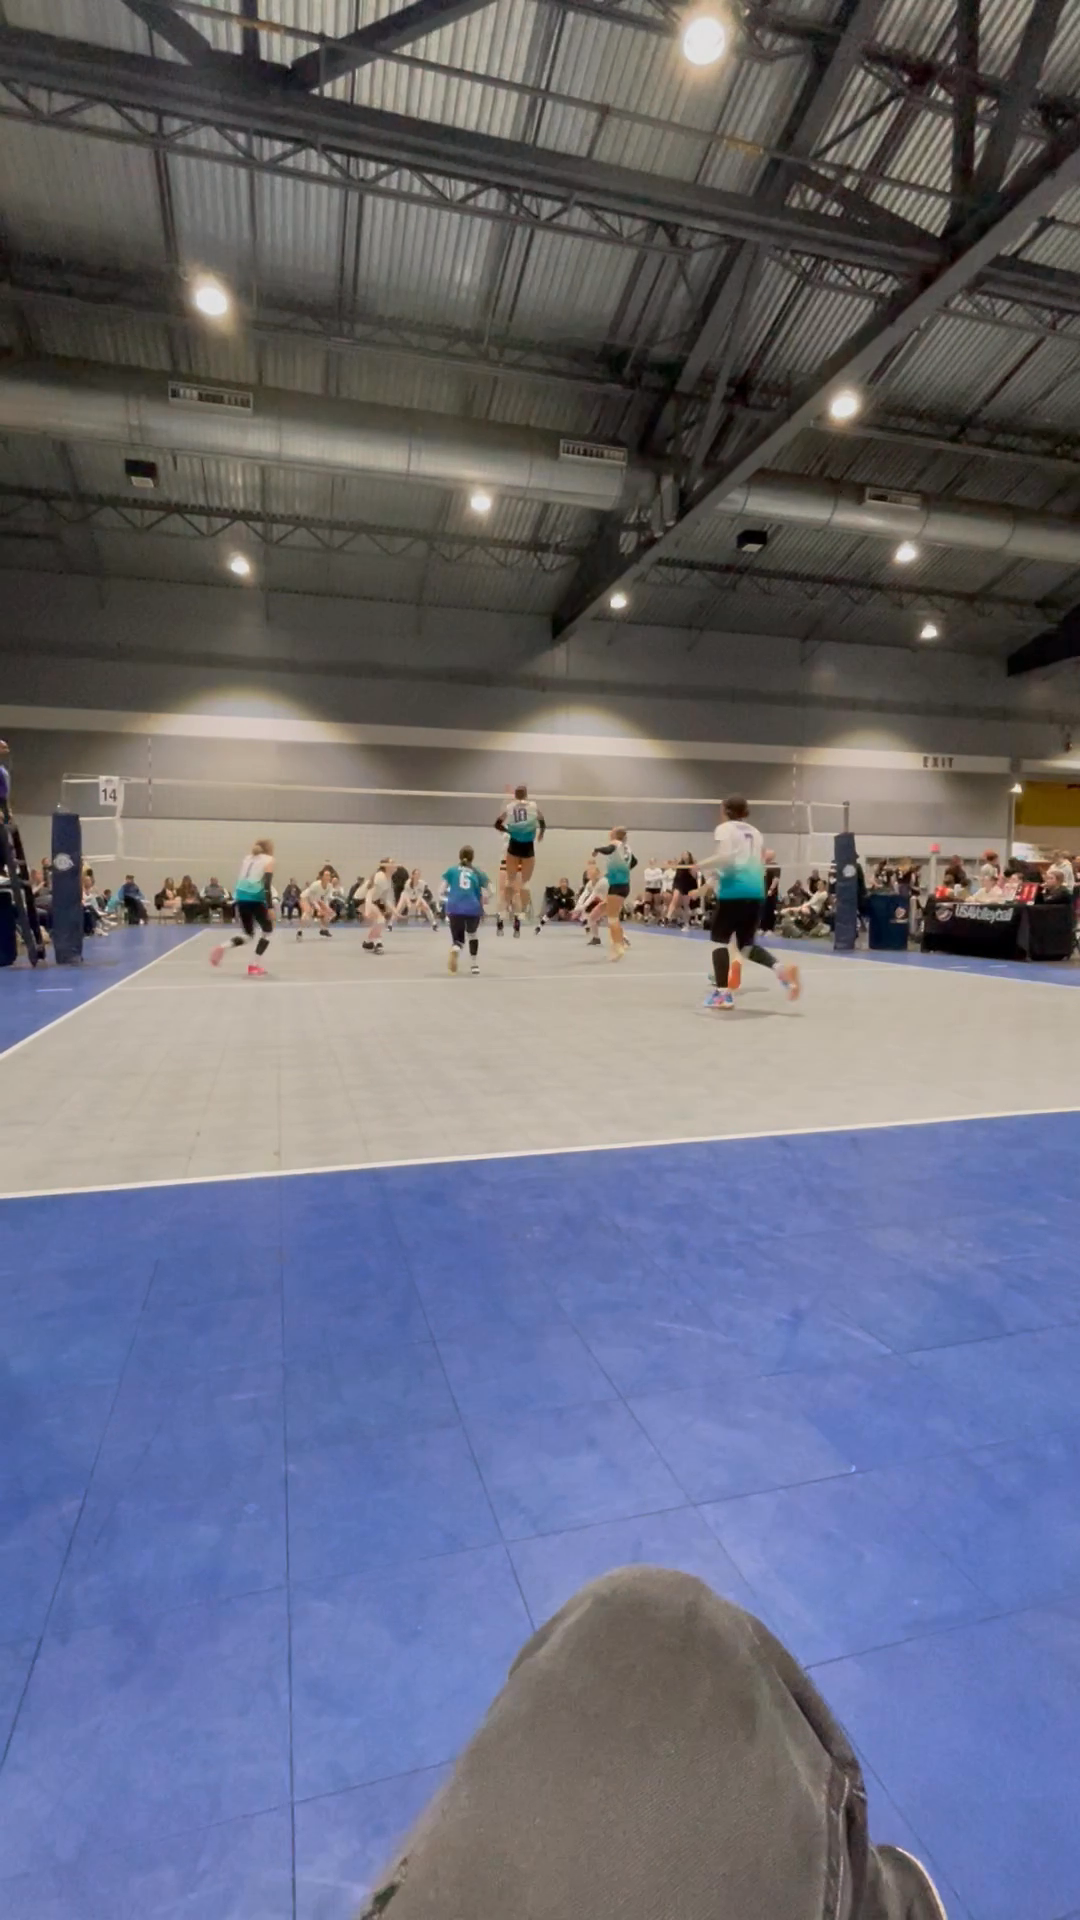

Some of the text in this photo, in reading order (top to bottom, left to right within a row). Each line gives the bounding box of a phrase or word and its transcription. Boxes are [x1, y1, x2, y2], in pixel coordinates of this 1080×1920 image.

[922, 755, 954, 768] EXIT
[101, 787, 117, 802] 14
[513, 807, 527, 823] 10
[459, 871, 471, 889] 6
